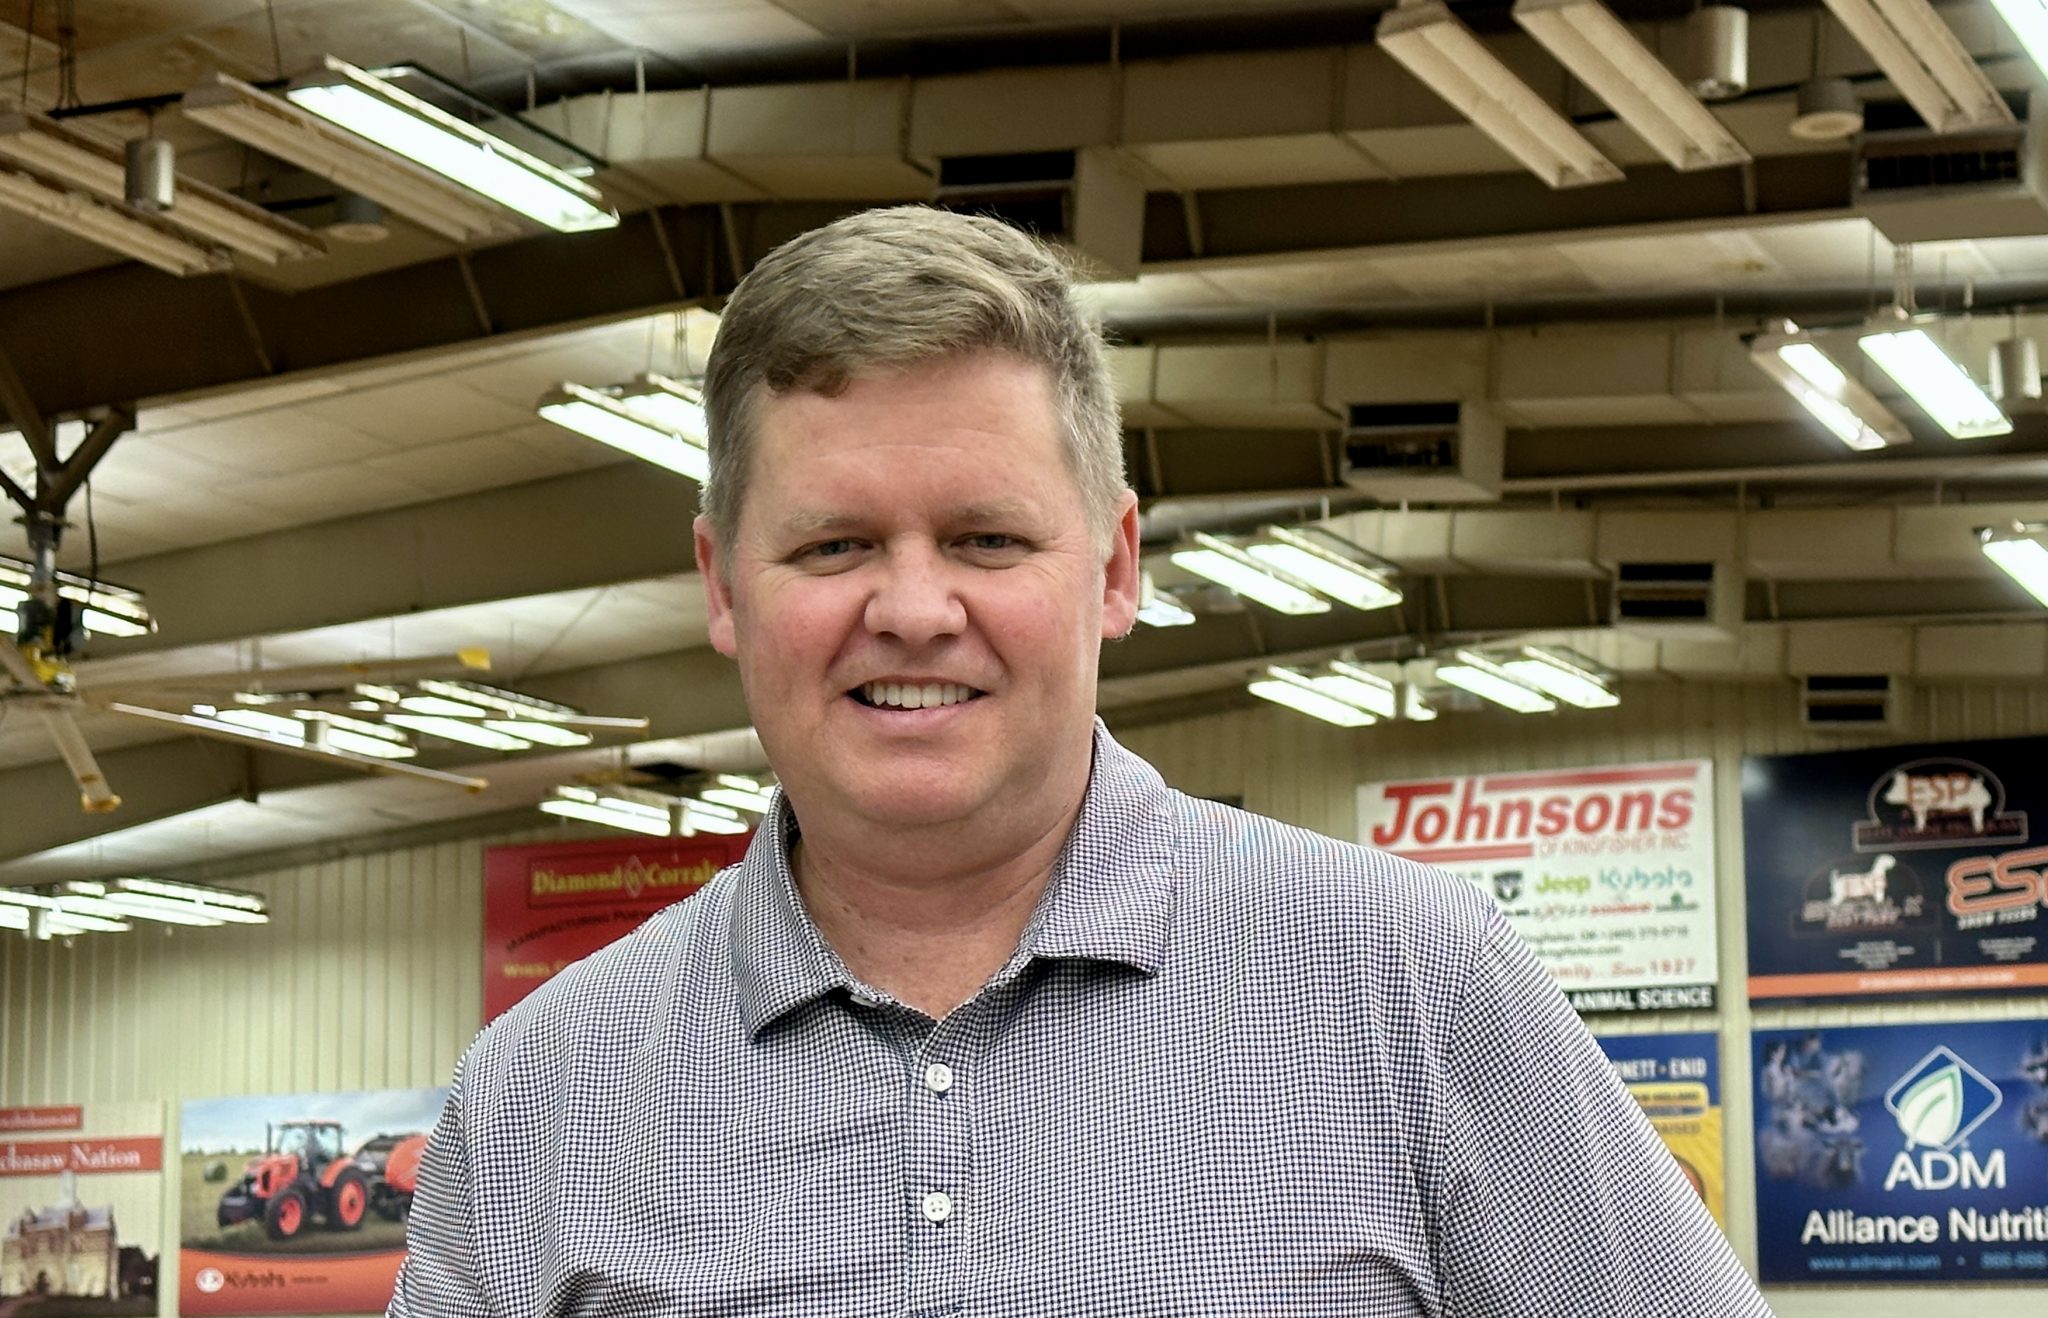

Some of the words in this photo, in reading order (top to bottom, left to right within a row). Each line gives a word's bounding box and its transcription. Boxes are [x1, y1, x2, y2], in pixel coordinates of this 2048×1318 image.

[1907, 772, 1970, 802] ESP
[1372, 776, 1695, 847] Johnsons
[532, 865, 622, 896] Diamond
[1536, 872, 1591, 895] Jeep
[1600, 865, 1693, 890] Kubota
[1945, 846, 2048, 916] ES
[1650, 956, 1697, 976] 1927
[1572, 990, 1636, 1012] ANIMAL
[1637, 986, 1714, 1011] SCIENCE
[1669, 1056, 1708, 1079] ENID
[71, 1142, 142, 1169] Nation
[1884, 1148, 2007, 1191] ADM
[1801, 1209, 1939, 1244] Alliance
[226, 1270, 286, 1288] Kubota
